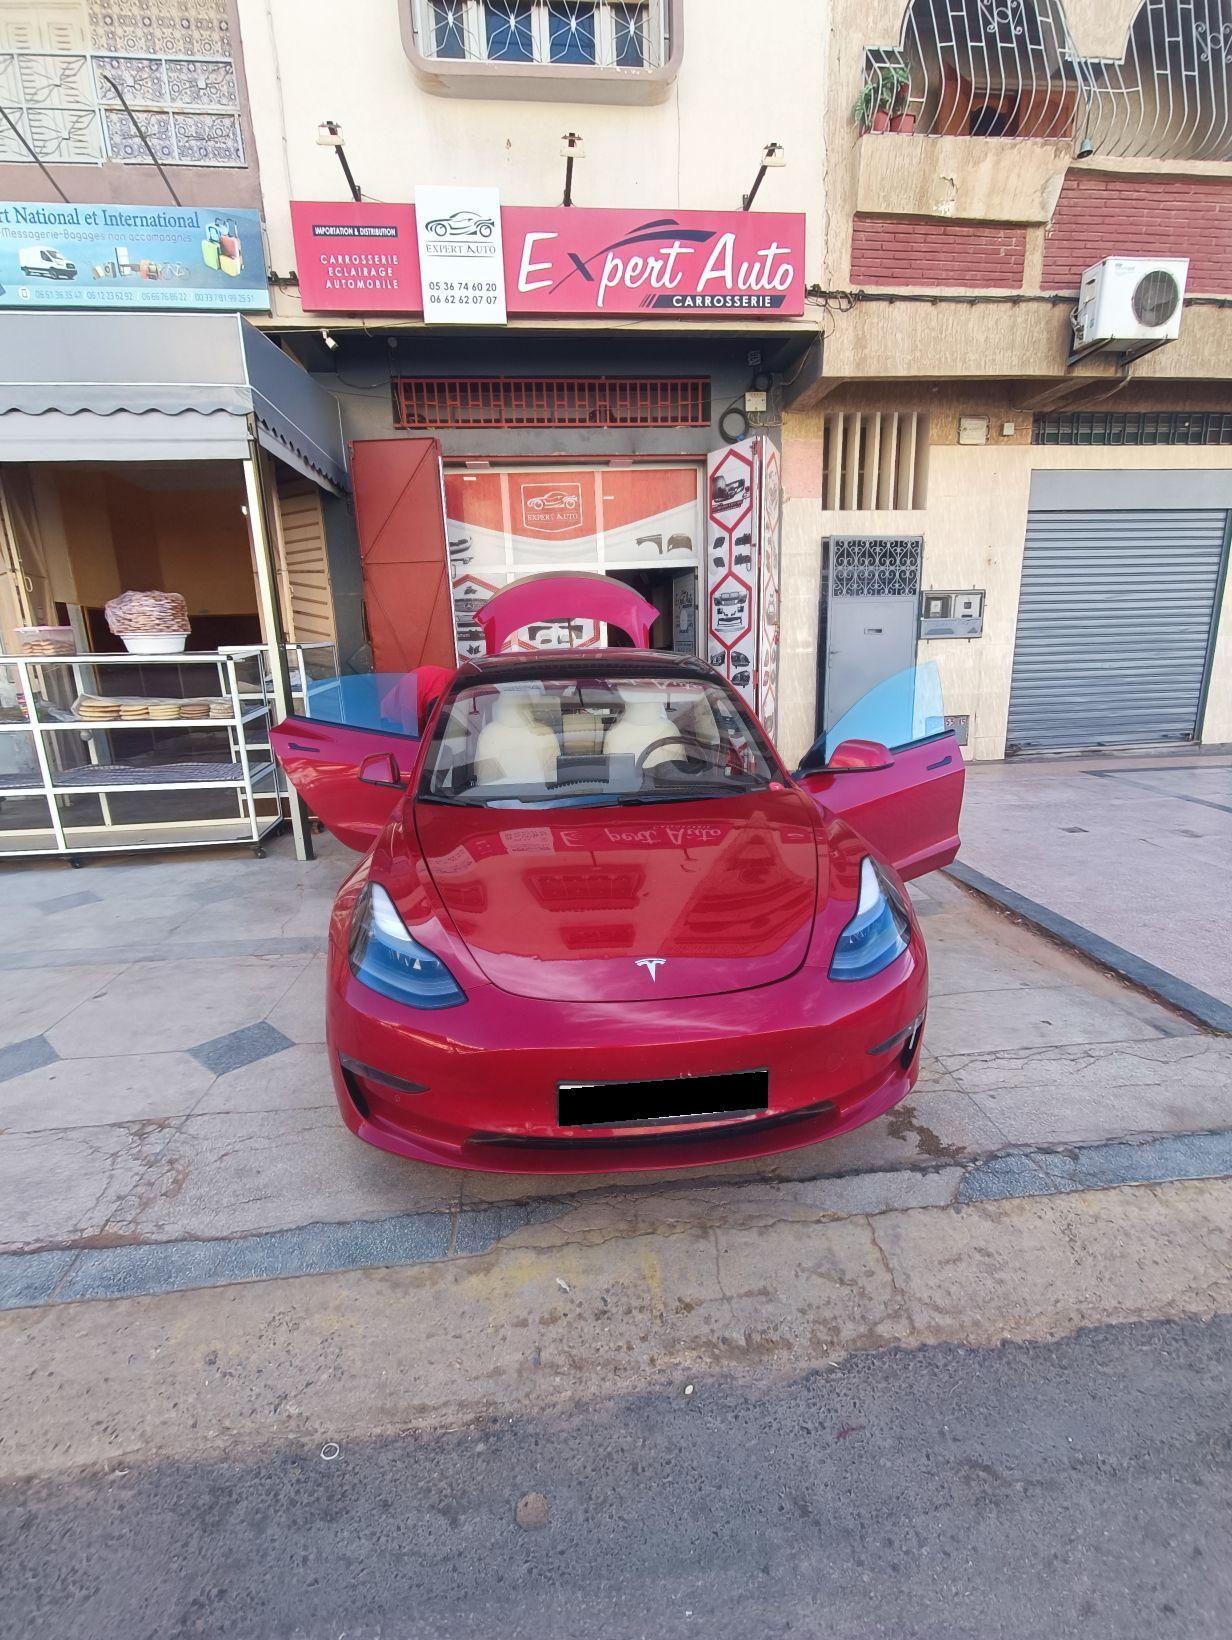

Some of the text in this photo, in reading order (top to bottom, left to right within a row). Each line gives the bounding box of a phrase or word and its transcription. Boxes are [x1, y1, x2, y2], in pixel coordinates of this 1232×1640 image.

[12, 206, 81, 226] National
[84, 211, 99, 226] et
[102, 209, 200, 229] International
[314, 226, 396, 237] IMPORTATION & DISTRIBUTION
[425, 243, 496, 254] EXPERT AUTO
[320, 254, 399, 265] CARROSSERIE
[327, 266, 393, 277] ECLAIRAGE
[517, 231, 794, 307] Expert Auto
[325, 279, 399, 289] AUTOMOBILE
[428, 281, 497, 292] 05 36 74 60 20
[429, 294, 497, 305] 06 62 62 07 07
[672, 296, 771, 308] CARROSSERIE
[556, 512, 578, 520] AUTO
